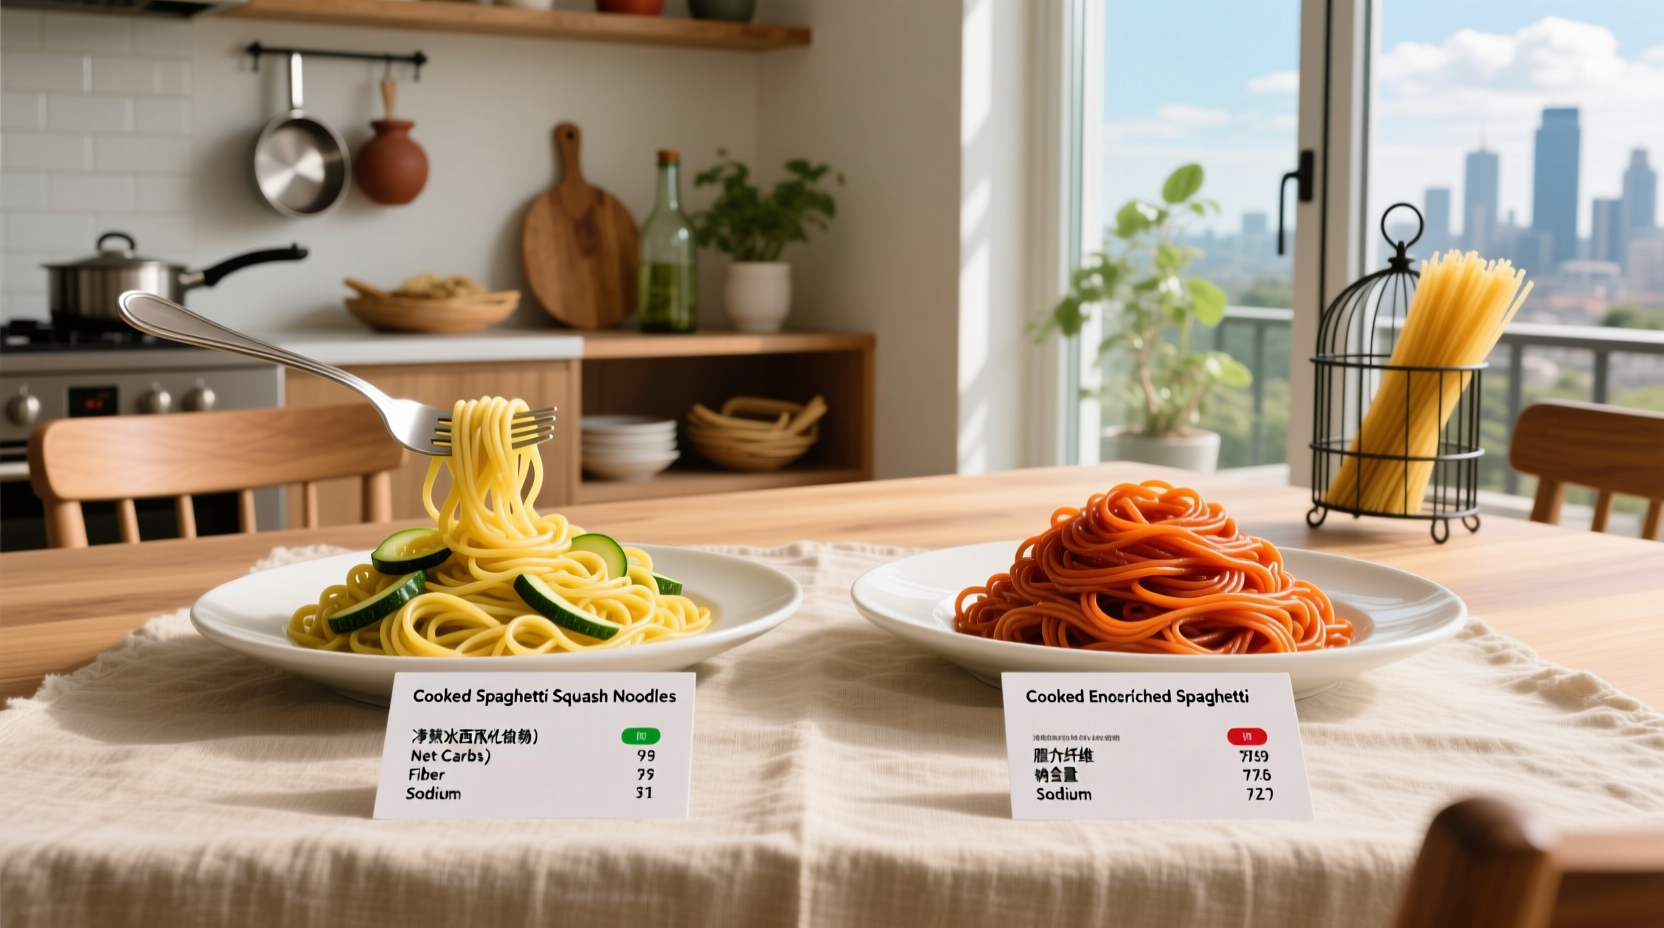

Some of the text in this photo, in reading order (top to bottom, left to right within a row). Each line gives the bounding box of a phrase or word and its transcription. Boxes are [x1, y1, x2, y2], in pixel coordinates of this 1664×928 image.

[413, 688, 677, 706] Cooked Spaghetti Squash Noodles
[1026, 689, 1084, 704] Cooked
[1176, 688, 1250, 706] Spaghetti
[411, 749, 438, 762] Net
[408, 766, 446, 781] Fiber
[406, 786, 462, 800] Sodium
[1036, 786, 1092, 801] Sodium
